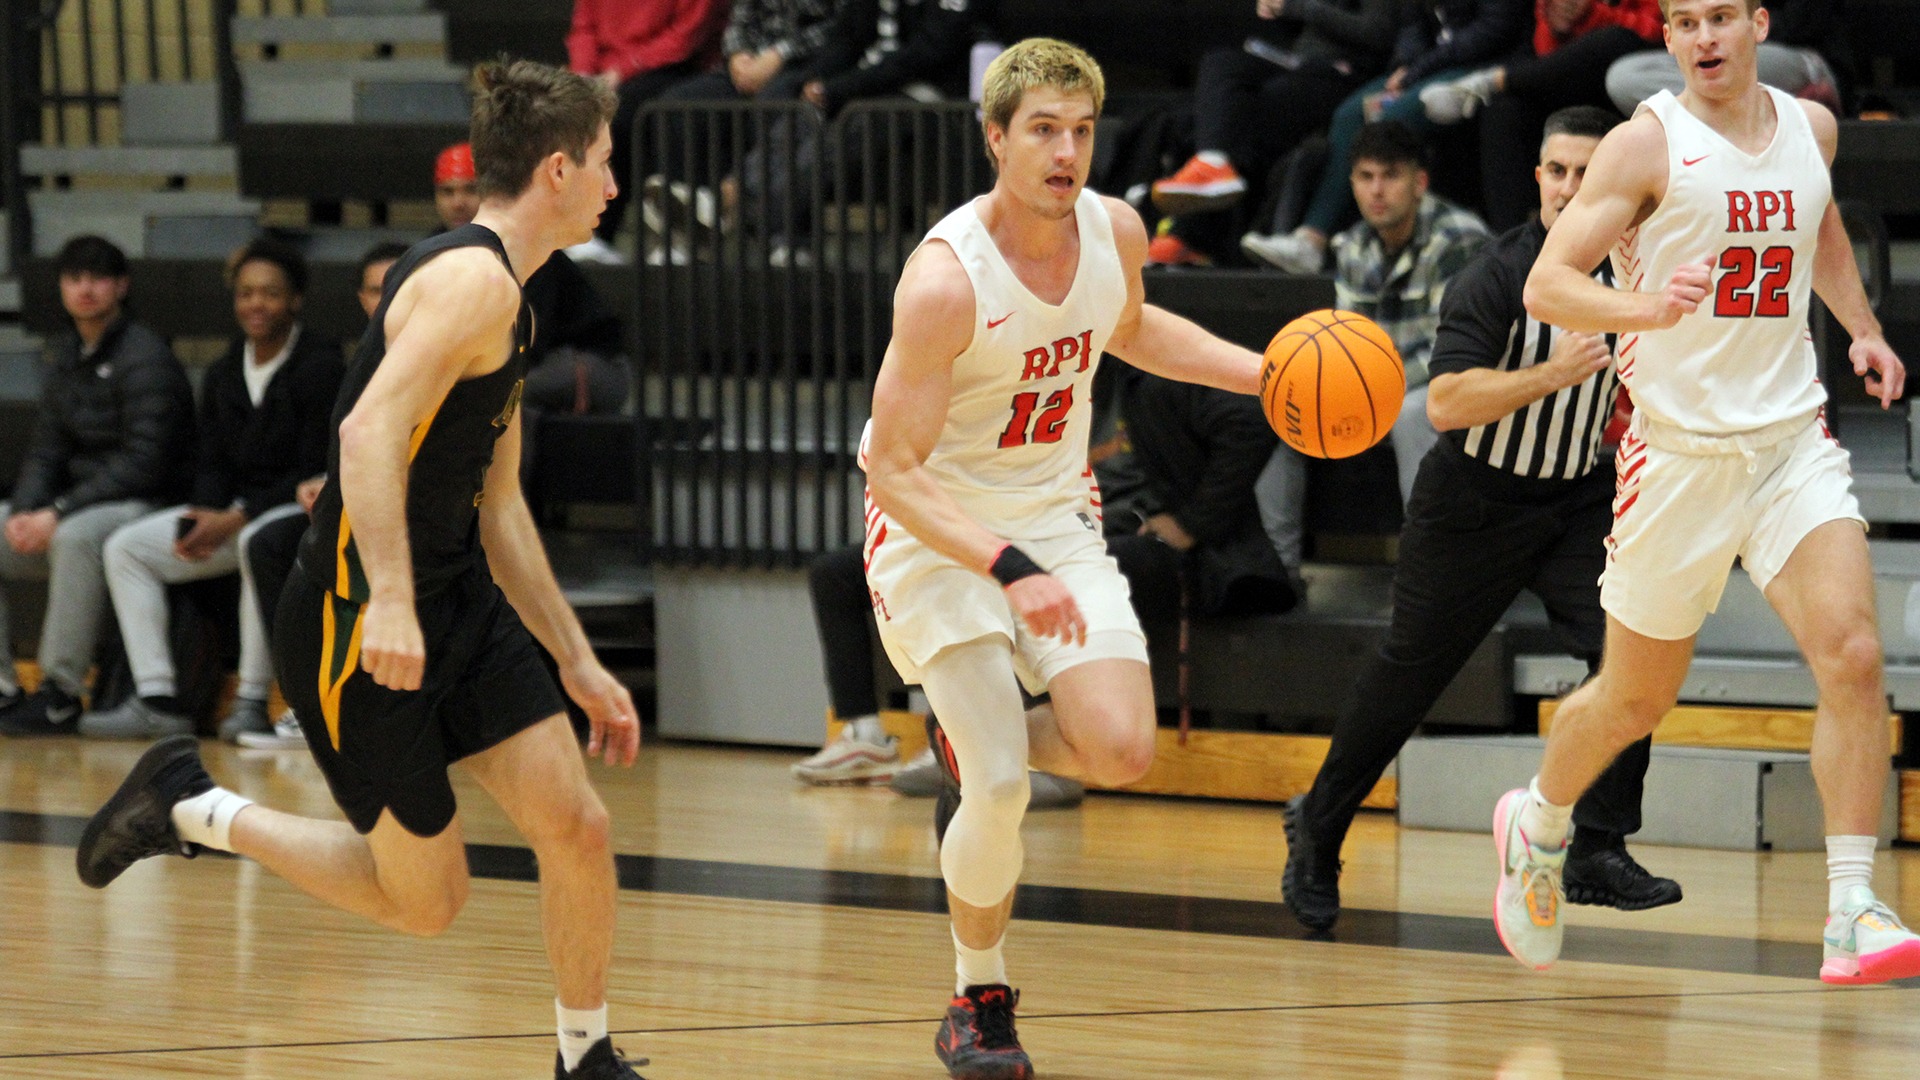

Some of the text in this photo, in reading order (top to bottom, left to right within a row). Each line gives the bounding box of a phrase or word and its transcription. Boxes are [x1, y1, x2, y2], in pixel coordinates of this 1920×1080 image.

[1724, 190, 1797, 233] RPI
[1713, 245, 1794, 318] 22
[1019, 329, 1094, 382] RPI
[997, 383, 1074, 449] 12
